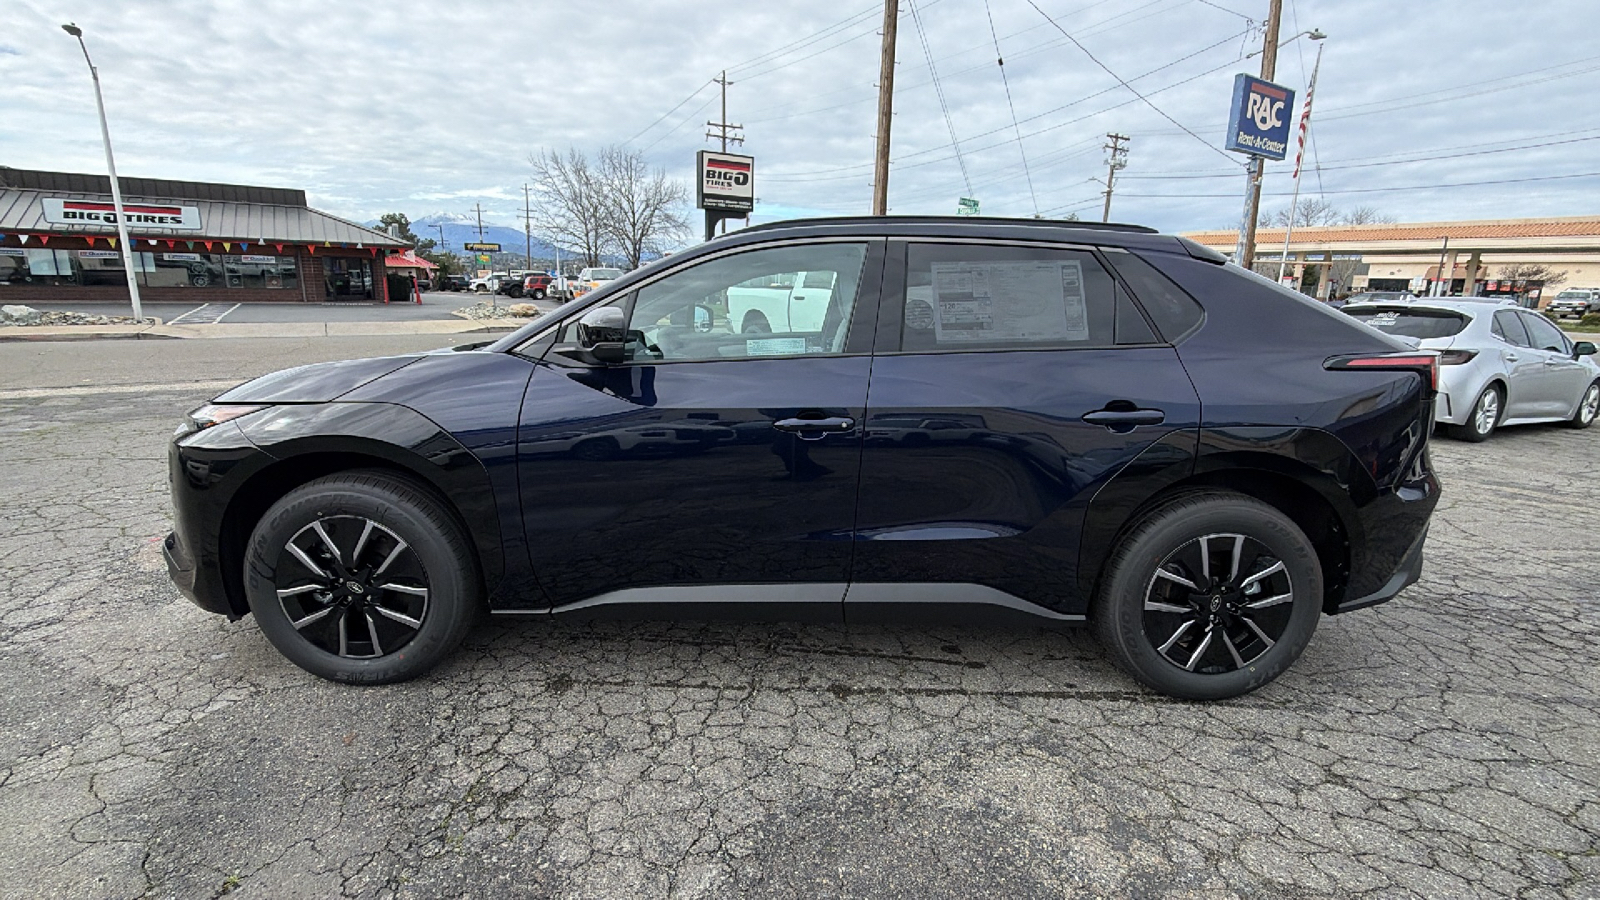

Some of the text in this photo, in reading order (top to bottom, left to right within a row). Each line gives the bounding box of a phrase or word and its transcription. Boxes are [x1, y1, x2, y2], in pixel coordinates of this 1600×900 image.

[1246, 92, 1285, 131] RAC
[706, 170, 749, 186] BIG O
[63, 211, 101, 221] BIG
[123, 213, 183, 225] TIRES
